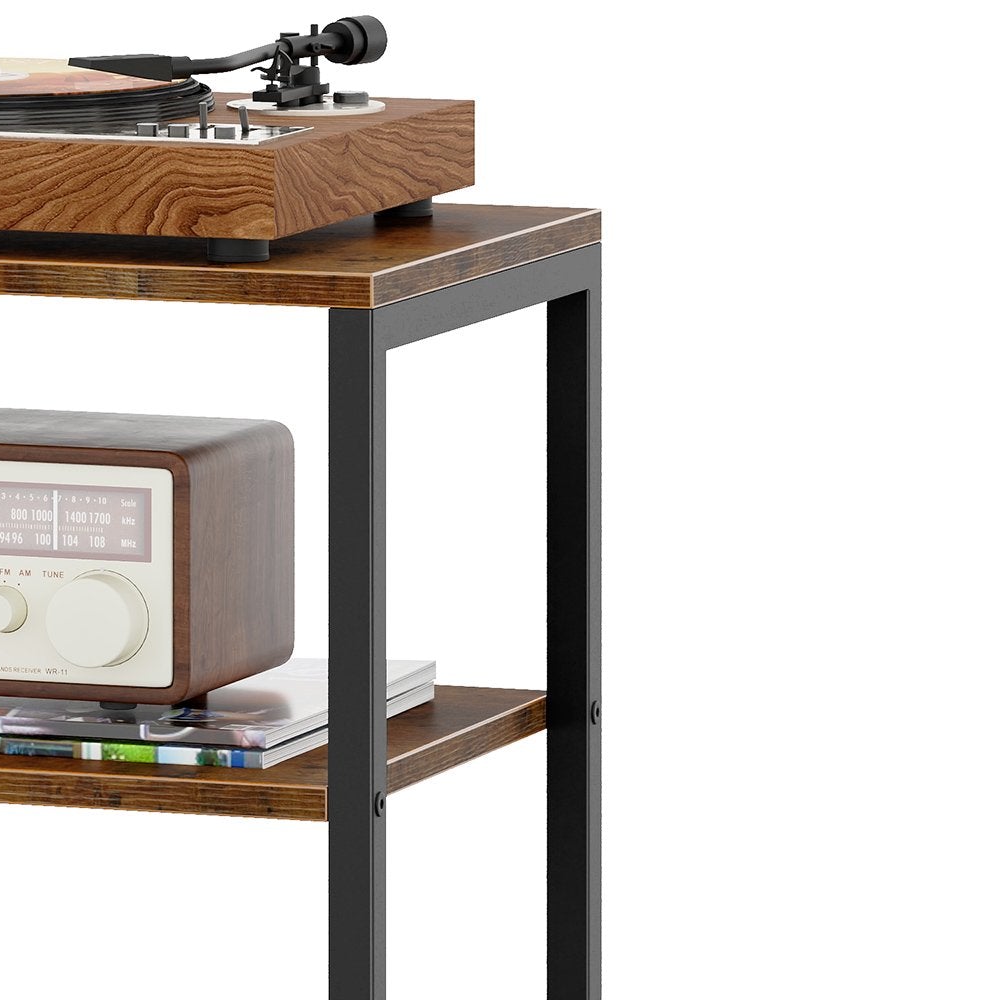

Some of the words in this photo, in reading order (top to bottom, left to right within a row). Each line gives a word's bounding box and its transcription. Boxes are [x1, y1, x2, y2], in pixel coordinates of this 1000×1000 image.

[120, 498, 136, 508] Scale
[11, 508, 28, 520] 800
[32, 509, 52, 522] 1000
[65, 510, 87, 524] 1400
[90, 512, 111, 525] 1700
[122, 516, 136, 526] kHz
[0, 532, 10, 544] 94
[12, 532, 23, 544] 96
[36, 533, 51, 546] 100
[62, 534, 78, 546] 104
[89, 536, 106, 548] 108
[120, 538, 136, 548] MHz
[0, 568, 11, 576] FM
[42, 570, 64, 578] TUNE
[46, 668, 68, 676] WR-11
